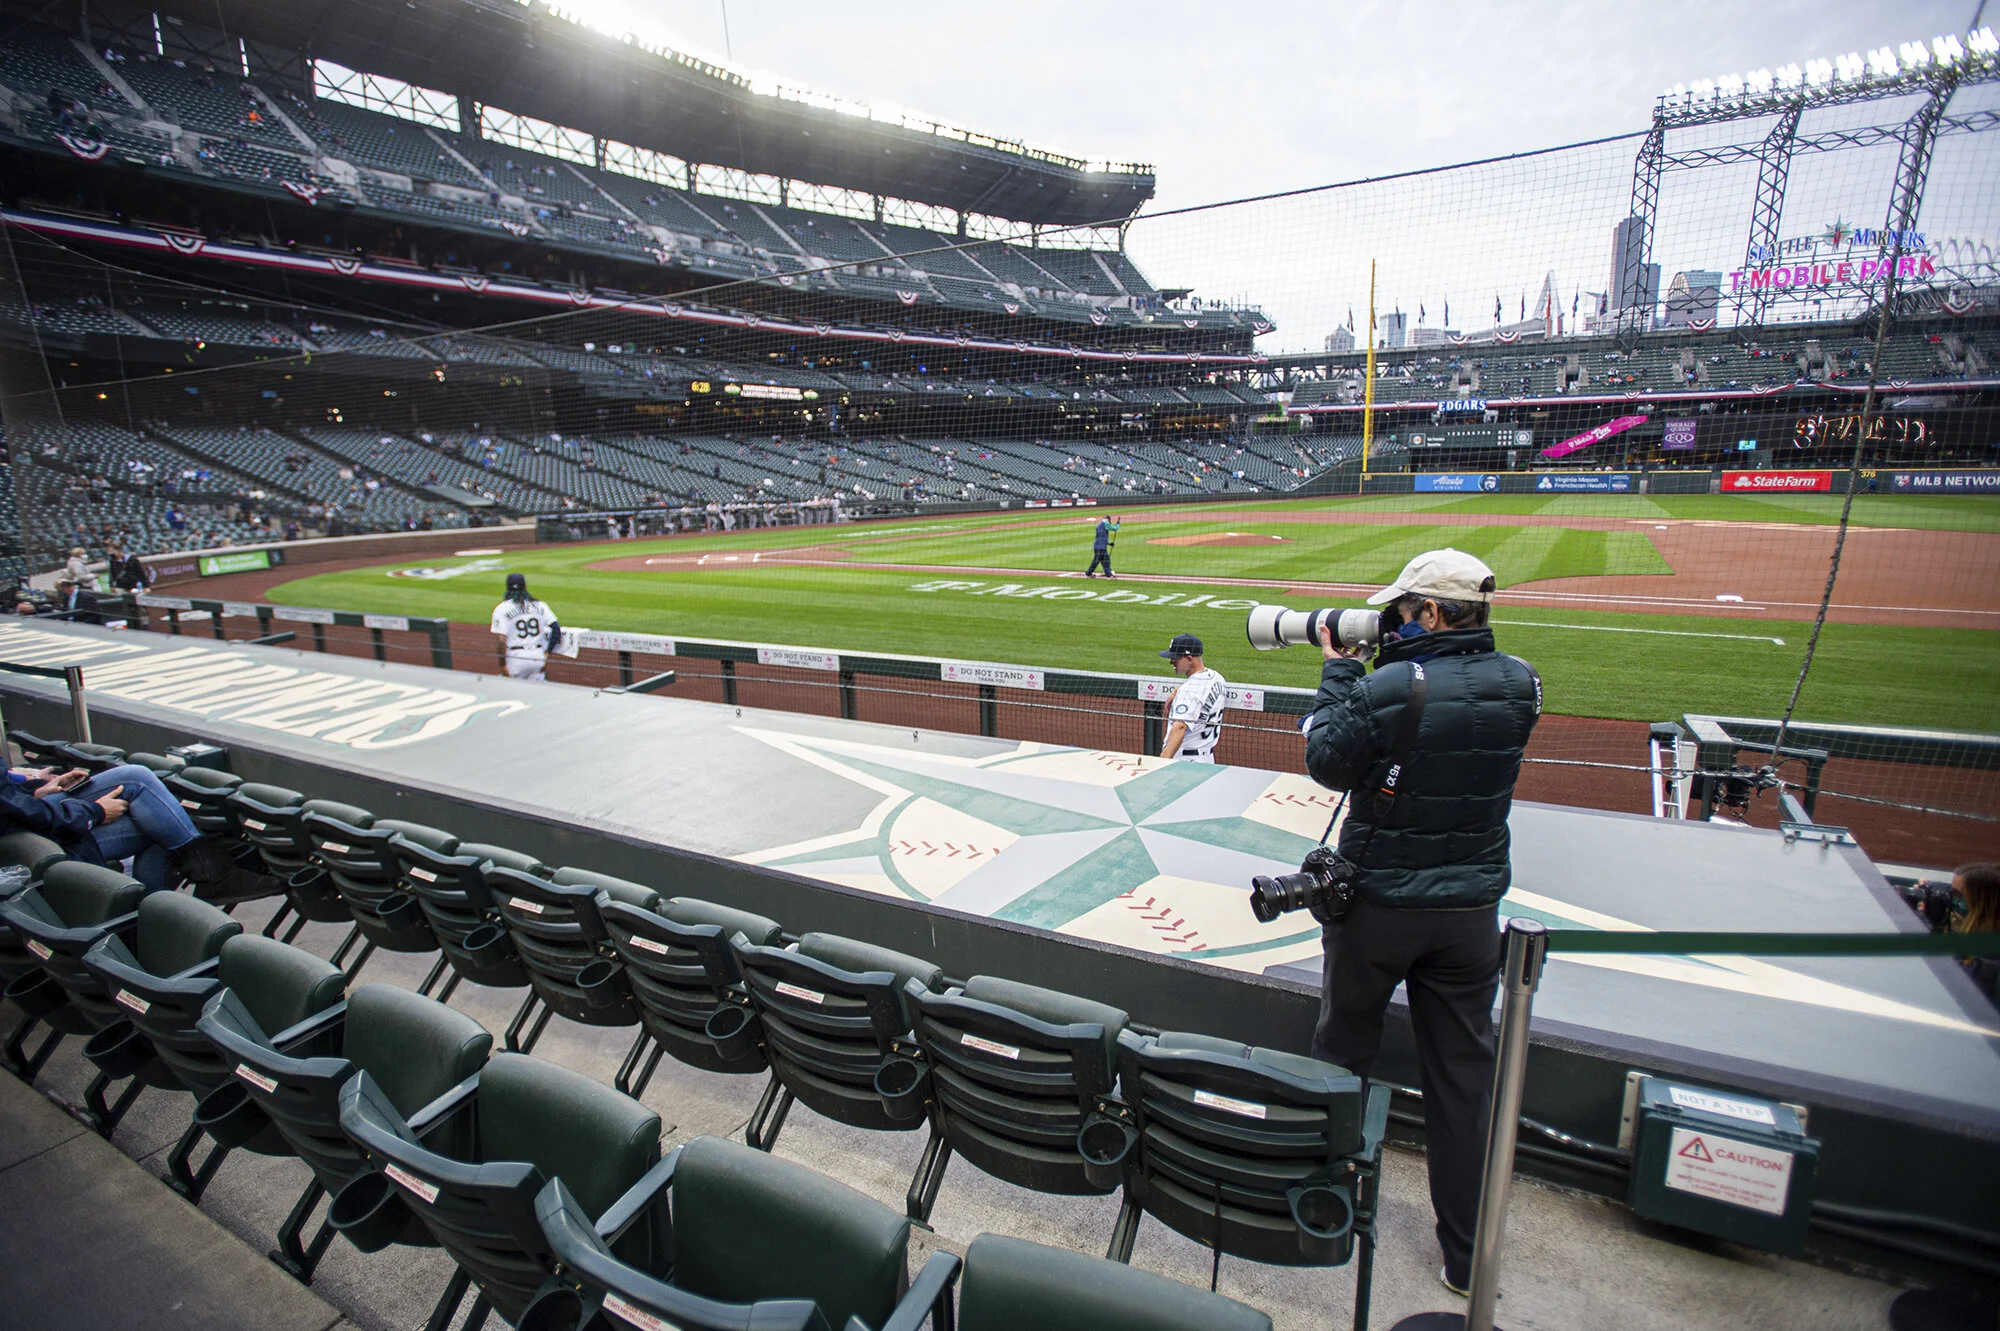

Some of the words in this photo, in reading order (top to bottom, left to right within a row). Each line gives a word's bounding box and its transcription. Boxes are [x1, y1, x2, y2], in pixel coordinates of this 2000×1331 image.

[1729, 262, 1851, 291] T-MOBILE
[1859, 255, 1937, 281] PARK
[691, 381, 711, 393] 6:28
[1437, 400, 1486, 412] EDGARS
[1913, 476, 1942, 486] MLB
[516, 617, 540, 639] 99
[799, 654, 823, 662] STAND
[960, 667, 972, 675] DO
[975, 669, 992, 677] NOT
[994, 671, 1024, 680] STAND
[62, 646, 532, 750] MARINERS
[1677, 1092, 1707, 1107] NOT
[1713, 1100, 1725, 1110] A
[1727, 1104, 1765, 1118] STEP
[1715, 1148, 1784, 1172] CAUTION
